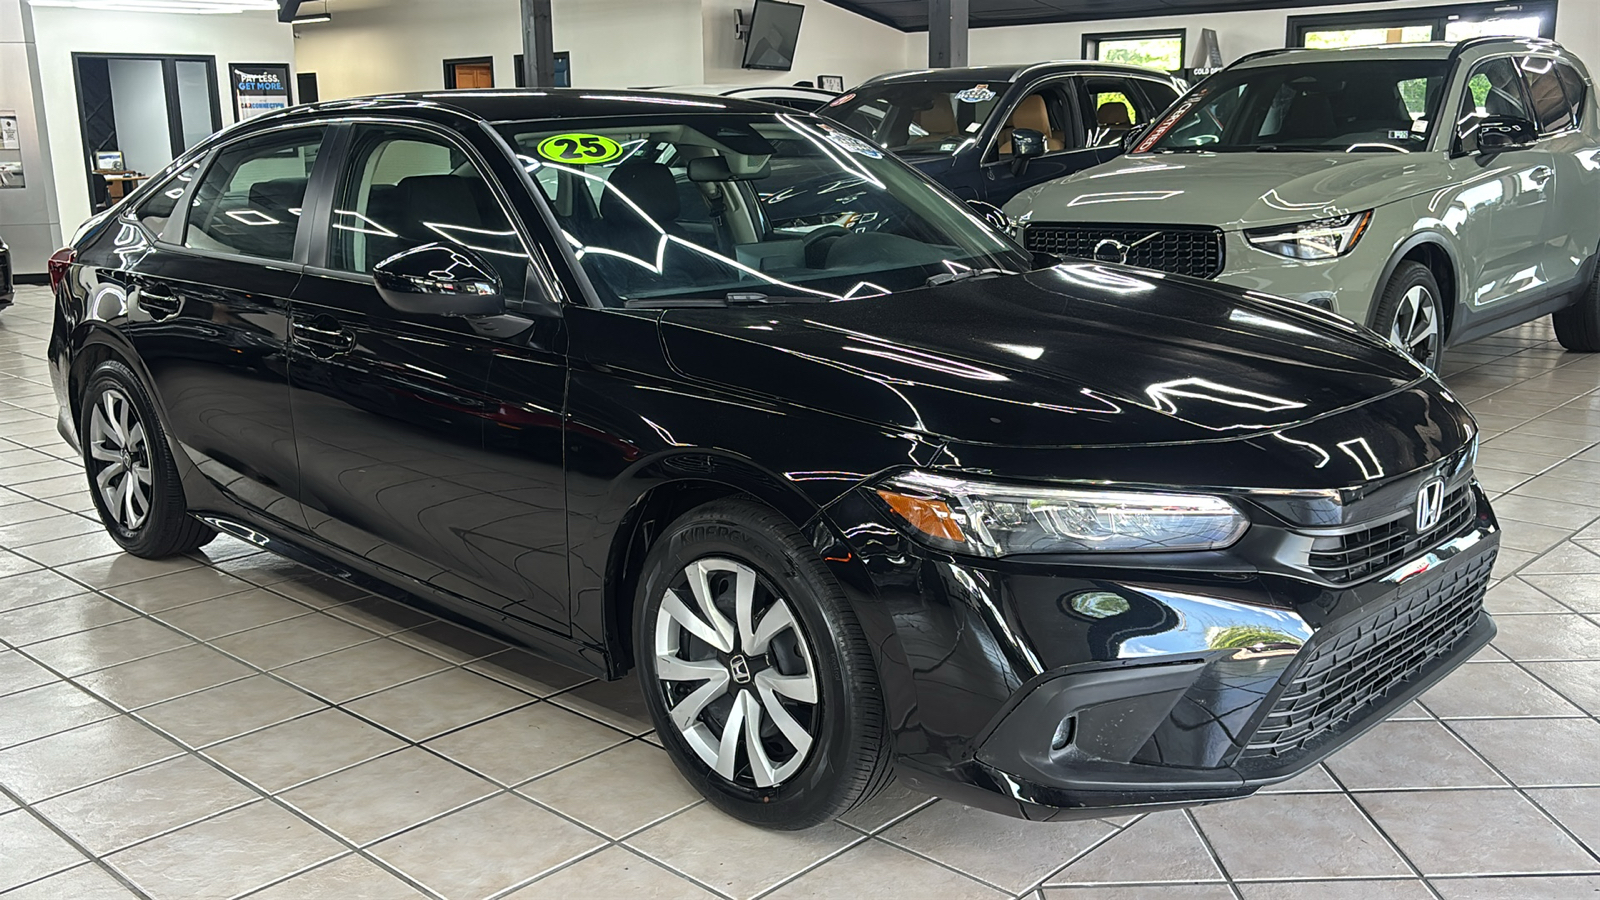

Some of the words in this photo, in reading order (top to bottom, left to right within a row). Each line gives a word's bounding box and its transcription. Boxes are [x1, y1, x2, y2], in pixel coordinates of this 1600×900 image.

[1193, 67, 1210, 76] COLD
[241, 74, 256, 82] PAY
[259, 74, 280, 83] LESS.
[553, 137, 607, 160] 25
